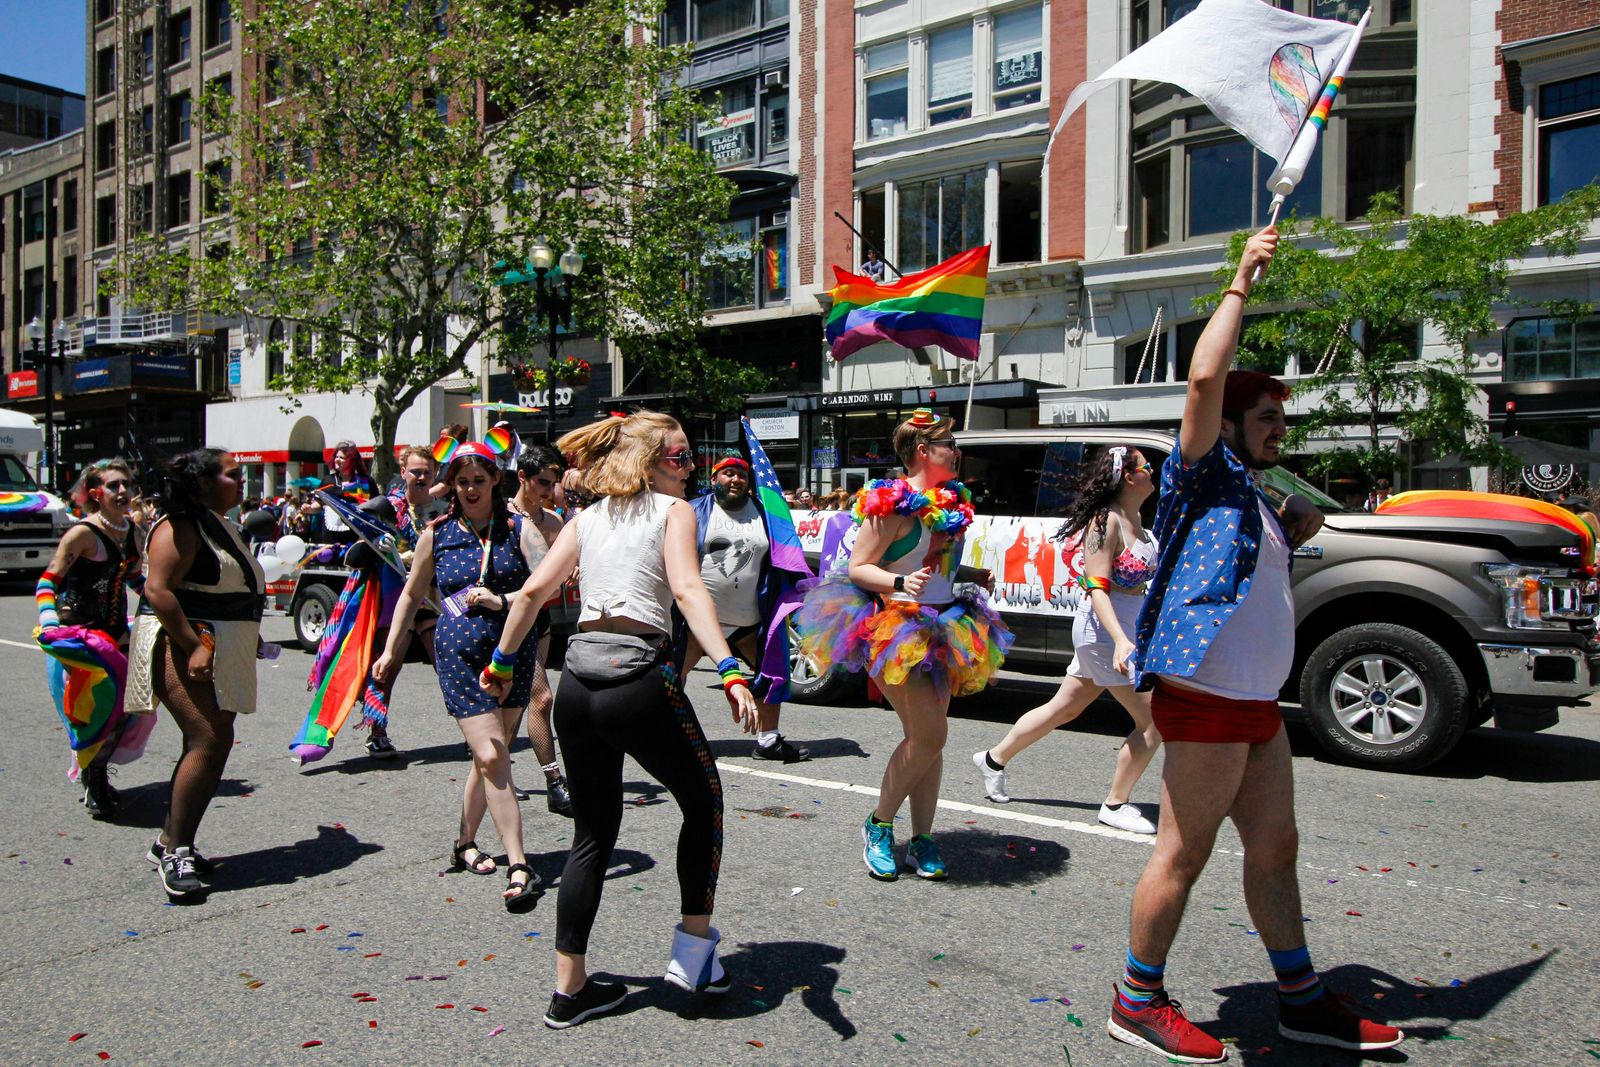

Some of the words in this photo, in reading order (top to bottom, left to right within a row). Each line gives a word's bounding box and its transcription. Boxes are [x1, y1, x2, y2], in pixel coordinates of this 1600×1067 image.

[712, 133, 739, 146] BLACK
[713, 141, 737, 153] LIVES
[239, 454, 263, 463] Santander
[1527, 473, 1552, 489] MEXICAN
[1552, 473, 1569, 487] GRILL
[993, 583, 1042, 609] TURE
[1049, 583, 1083, 612] SHO
[1327, 726, 1429, 758] WRANGLER
